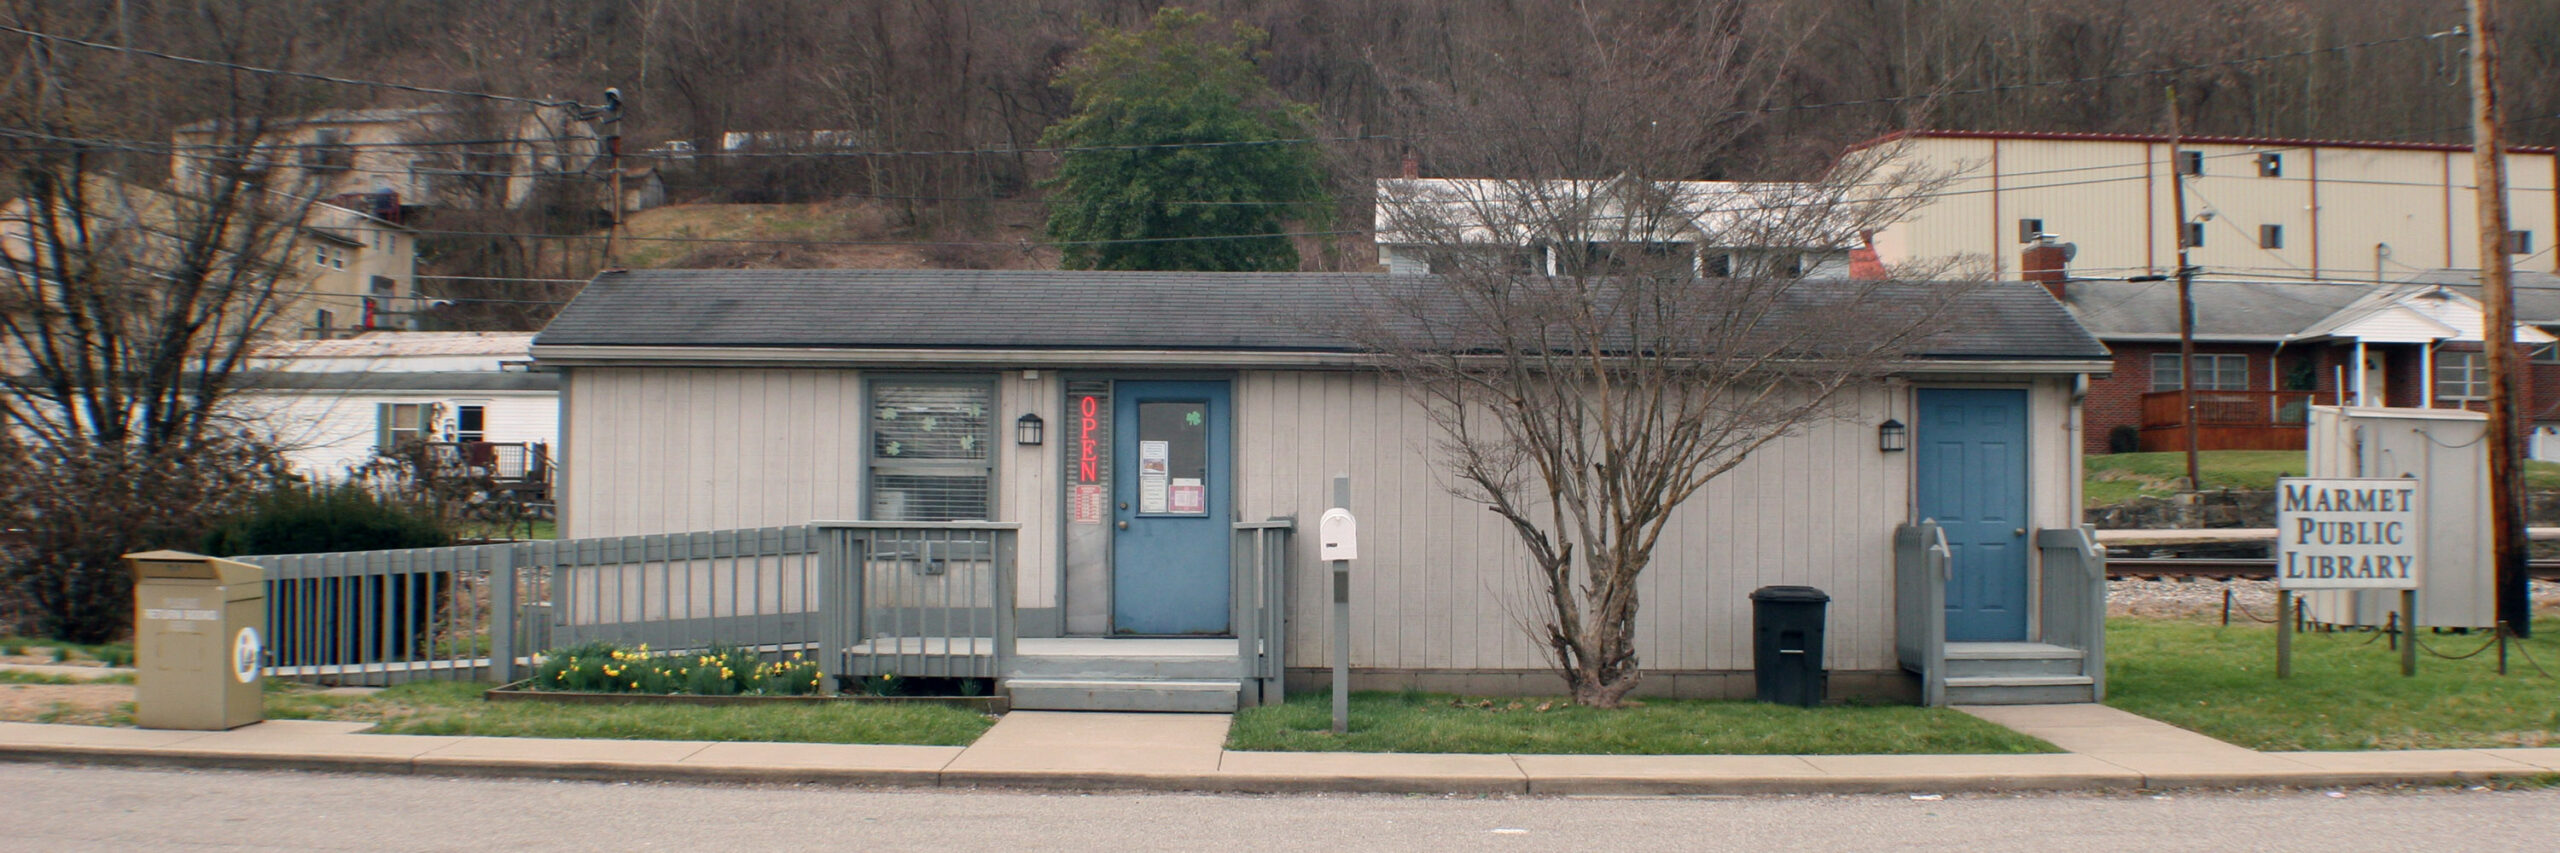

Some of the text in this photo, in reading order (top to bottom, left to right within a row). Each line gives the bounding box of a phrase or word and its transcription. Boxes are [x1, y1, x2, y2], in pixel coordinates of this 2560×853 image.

[1081, 396, 1097, 482] OPEN
[2284, 485, 2413, 512] MARMET
[2296, 517, 2402, 545] PUBLIC
[2285, 551, 2413, 579] LIBRARY
